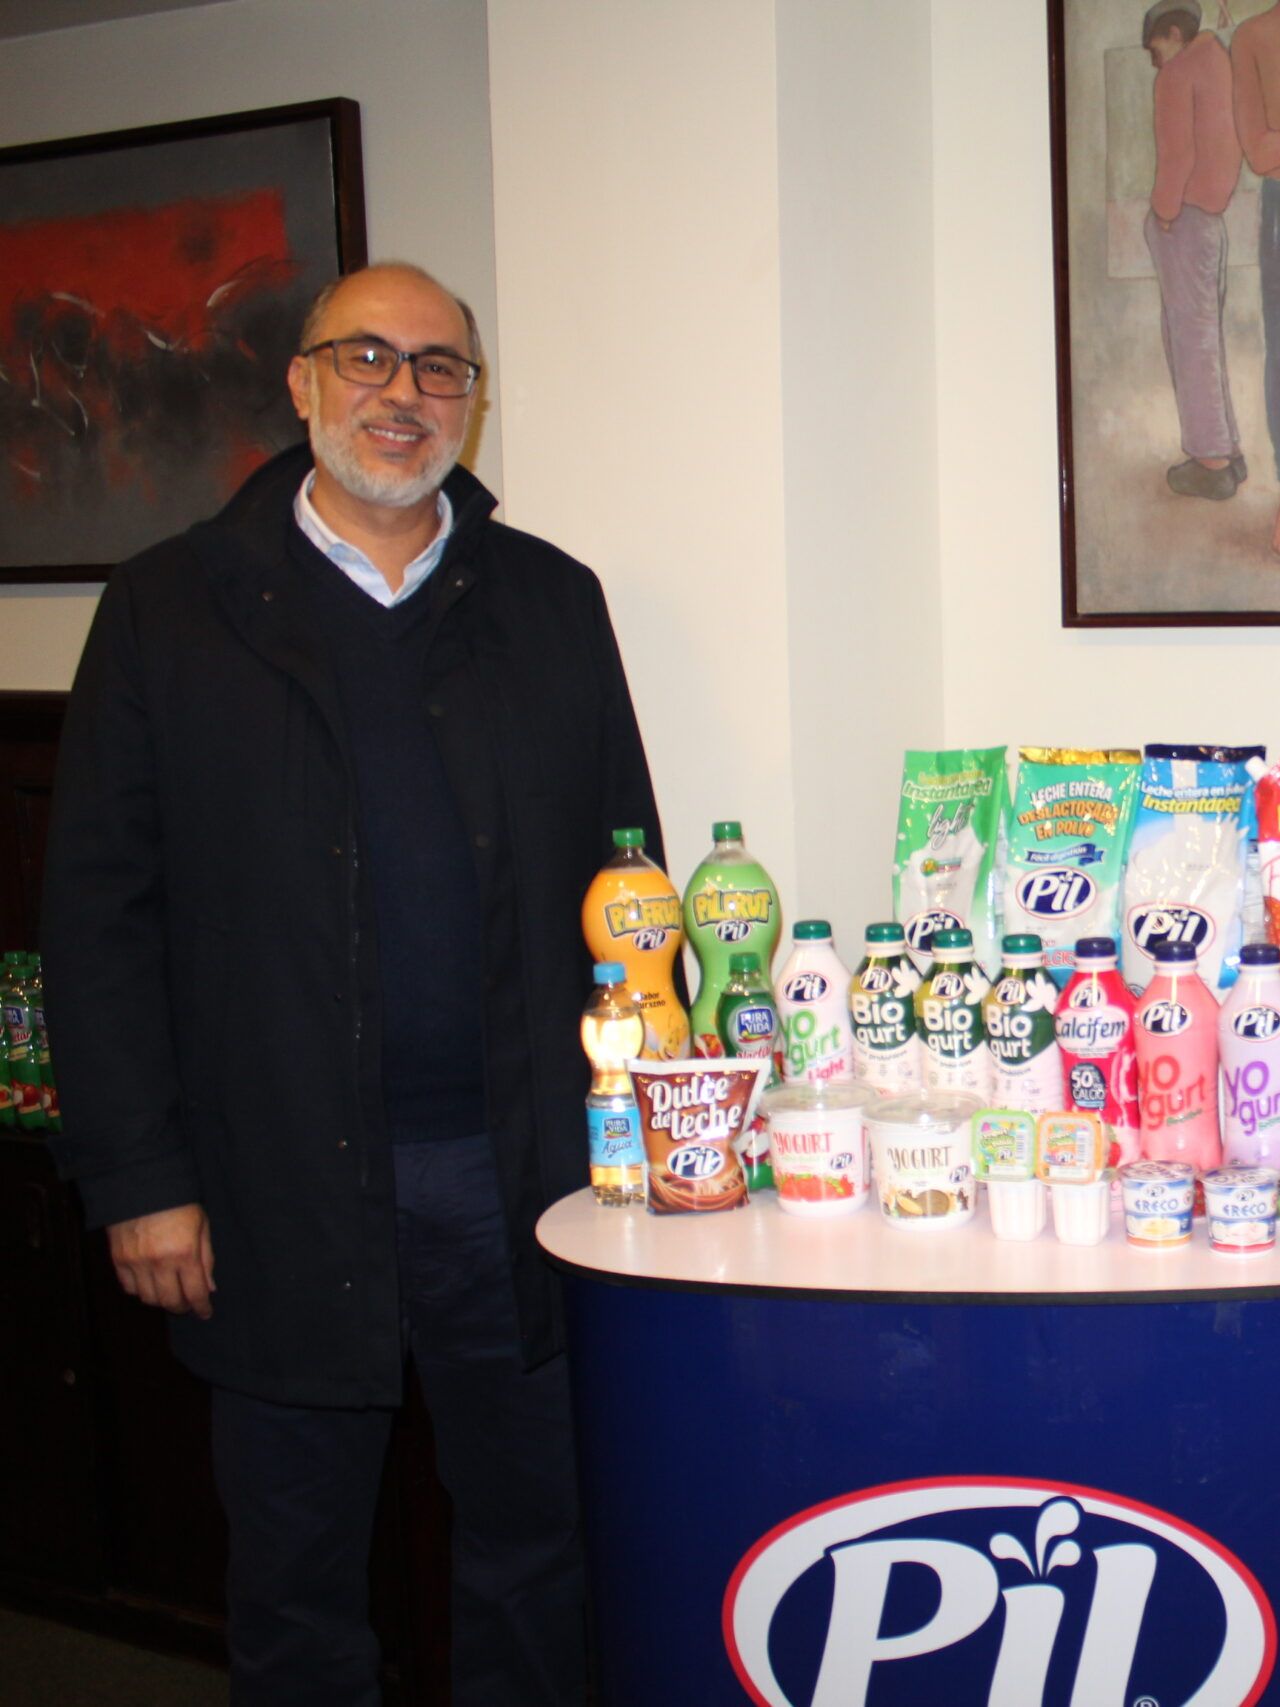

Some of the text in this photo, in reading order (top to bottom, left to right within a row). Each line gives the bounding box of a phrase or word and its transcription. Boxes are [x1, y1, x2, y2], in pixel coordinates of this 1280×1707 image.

[1031, 781, 1113, 804] LECHE ENTERA
[1024, 871, 1085, 912] Pil
[635, 930, 664, 948] Pil
[717, 920, 747, 940] Pil
[1135, 908, 1201, 948] Pil
[786, 973, 822, 1000] Pil
[935, 975, 958, 996] Pil
[740, 1011, 769, 1025] PURA
[852, 992, 905, 1025] Bio
[923, 1000, 974, 1031] Bio
[986, 1004, 1033, 1038] Bio
[1145, 1004, 1183, 1031] Pil
[745, 1022, 771, 1034] VIDA
[856, 1023, 908, 1047] gurt
[1055, 1016, 1125, 1046] Calcifem
[1236, 1008, 1276, 1038] Pil
[789, 1023, 841, 1077] gurt
[927, 1031, 973, 1054] gurt
[990, 1038, 1031, 1060] gurt
[646, 1074, 729, 1113] Dulce
[1072, 1087, 1106, 1101] CALCIO
[1146, 1073, 1206, 1131] gurt
[651, 1103, 742, 1140] de leche
[601, 1140, 634, 1158] Agua
[773, 1131, 835, 1156] YOGURT
[674, 1147, 716, 1176] Pil
[887, 1145, 953, 1172] YOGURT
[810, 1497, 1158, 1707] Pil
